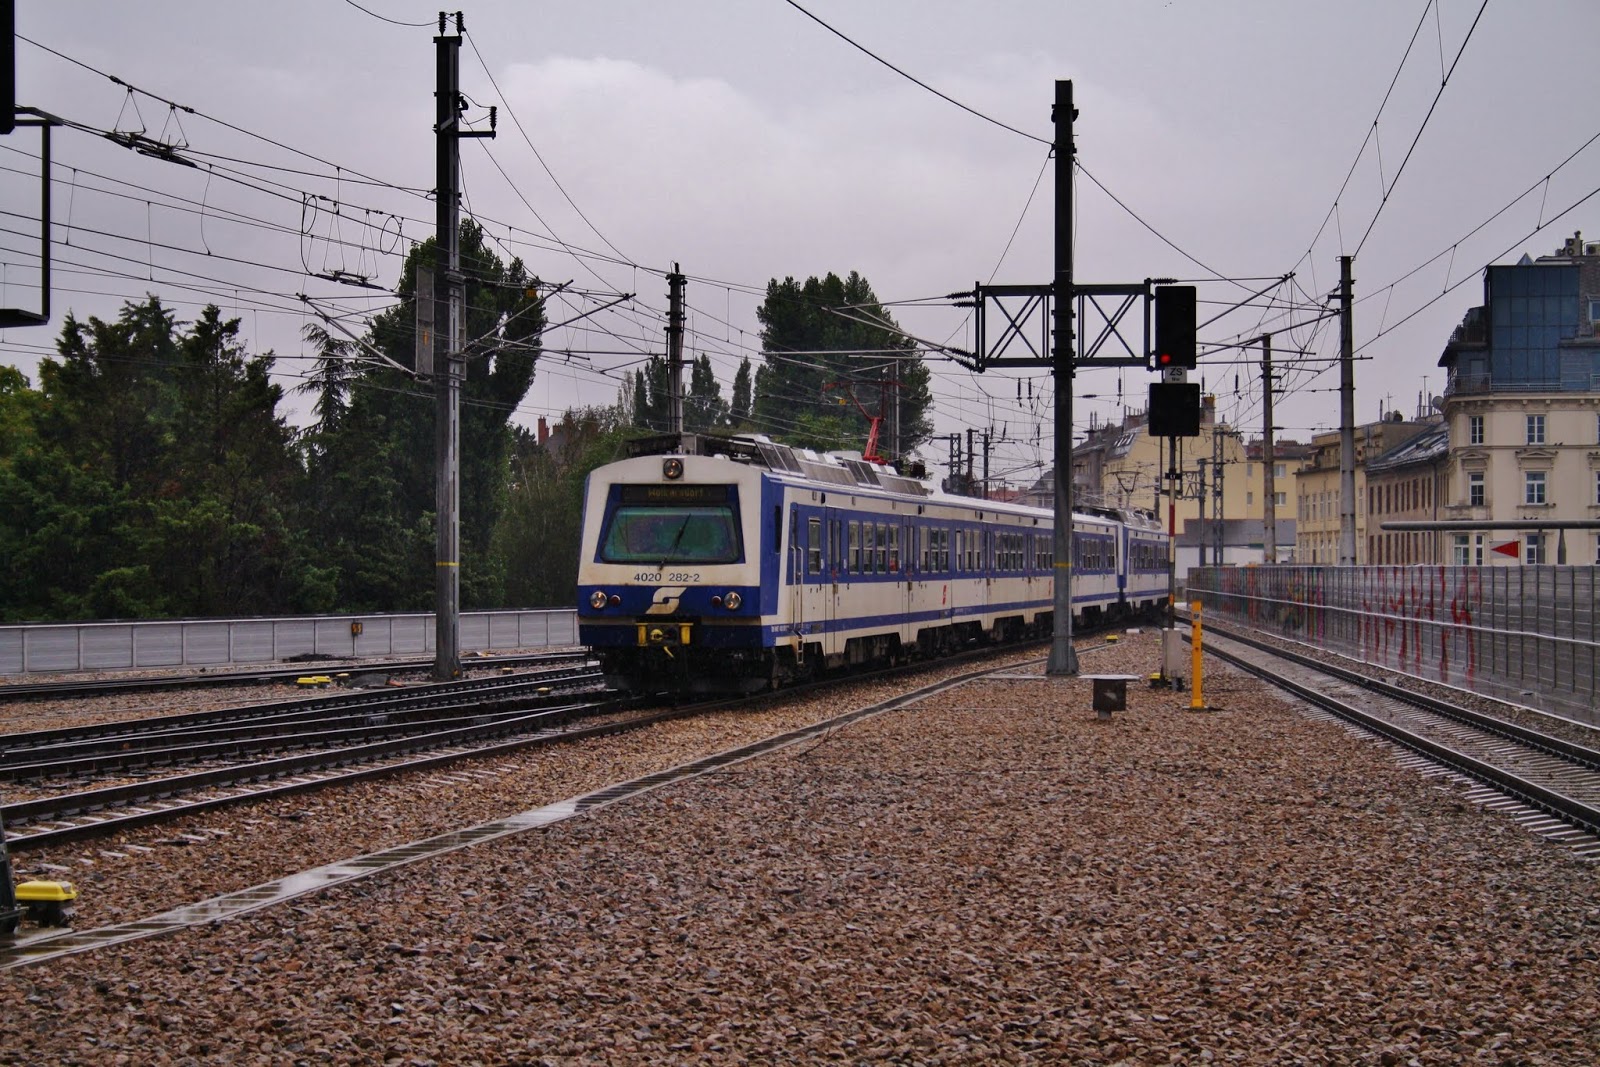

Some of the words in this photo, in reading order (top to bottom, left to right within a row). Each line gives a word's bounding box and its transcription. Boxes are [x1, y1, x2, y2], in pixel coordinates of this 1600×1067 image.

[1170, 367, 1182, 376] ZS
[634, 573, 662, 582] 4020
[669, 573, 700, 582] 282-2
